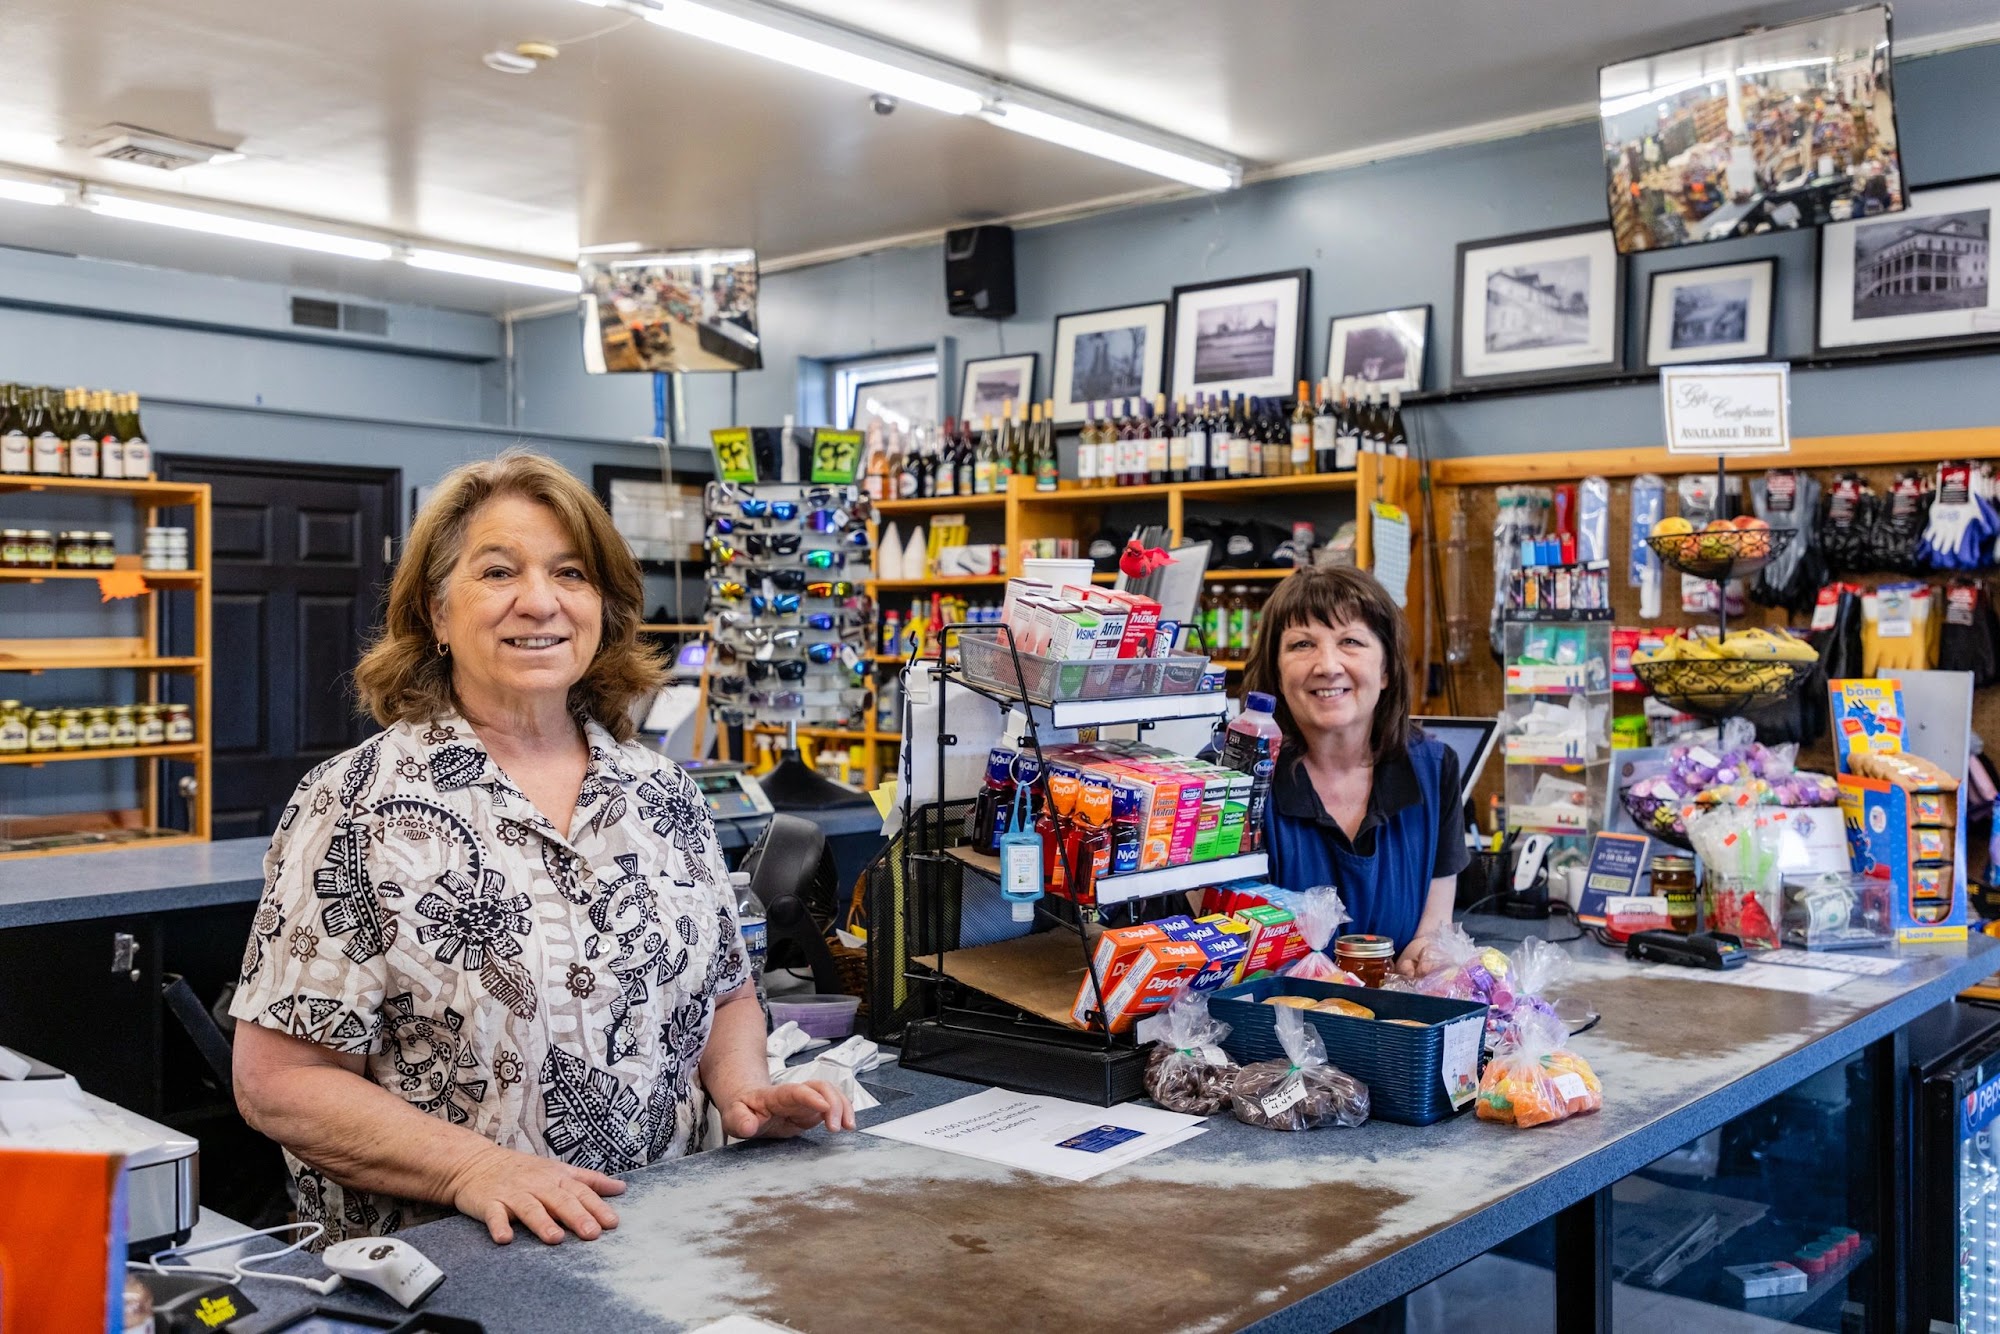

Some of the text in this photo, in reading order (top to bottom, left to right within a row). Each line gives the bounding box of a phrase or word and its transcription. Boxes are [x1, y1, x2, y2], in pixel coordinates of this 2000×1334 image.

[1681, 426, 1774, 438] AVAILABLE HERE
[1130, 612, 1159, 624] TYLENOL
[1076, 628, 1098, 640] VISINE
[1101, 622, 1122, 636] Afrin
[1846, 685, 1881, 697] bone
[991, 752, 1012, 766] NyQuil
[1019, 760, 1040, 772] NyQuil
[1052, 784, 1078, 796] DayQuil
[1084, 794, 1110, 806] DayQuil
[1253, 796, 1266, 808] 3X
[1154, 808, 1176, 817] Motrin
[1163, 918, 1189, 932] NyQuil
[1125, 927, 1158, 939] DayQuil
[1188, 927, 1214, 942] NyQuil
[1259, 923, 1292, 940] TYLENOL
[1906, 930, 1934, 939] bone
[1167, 944, 1198, 957] DayQuil
[1213, 938, 1238, 952] NyQuil
[1145, 973, 1194, 992] DayQuil
[1195, 967, 1231, 986] NyQuil
